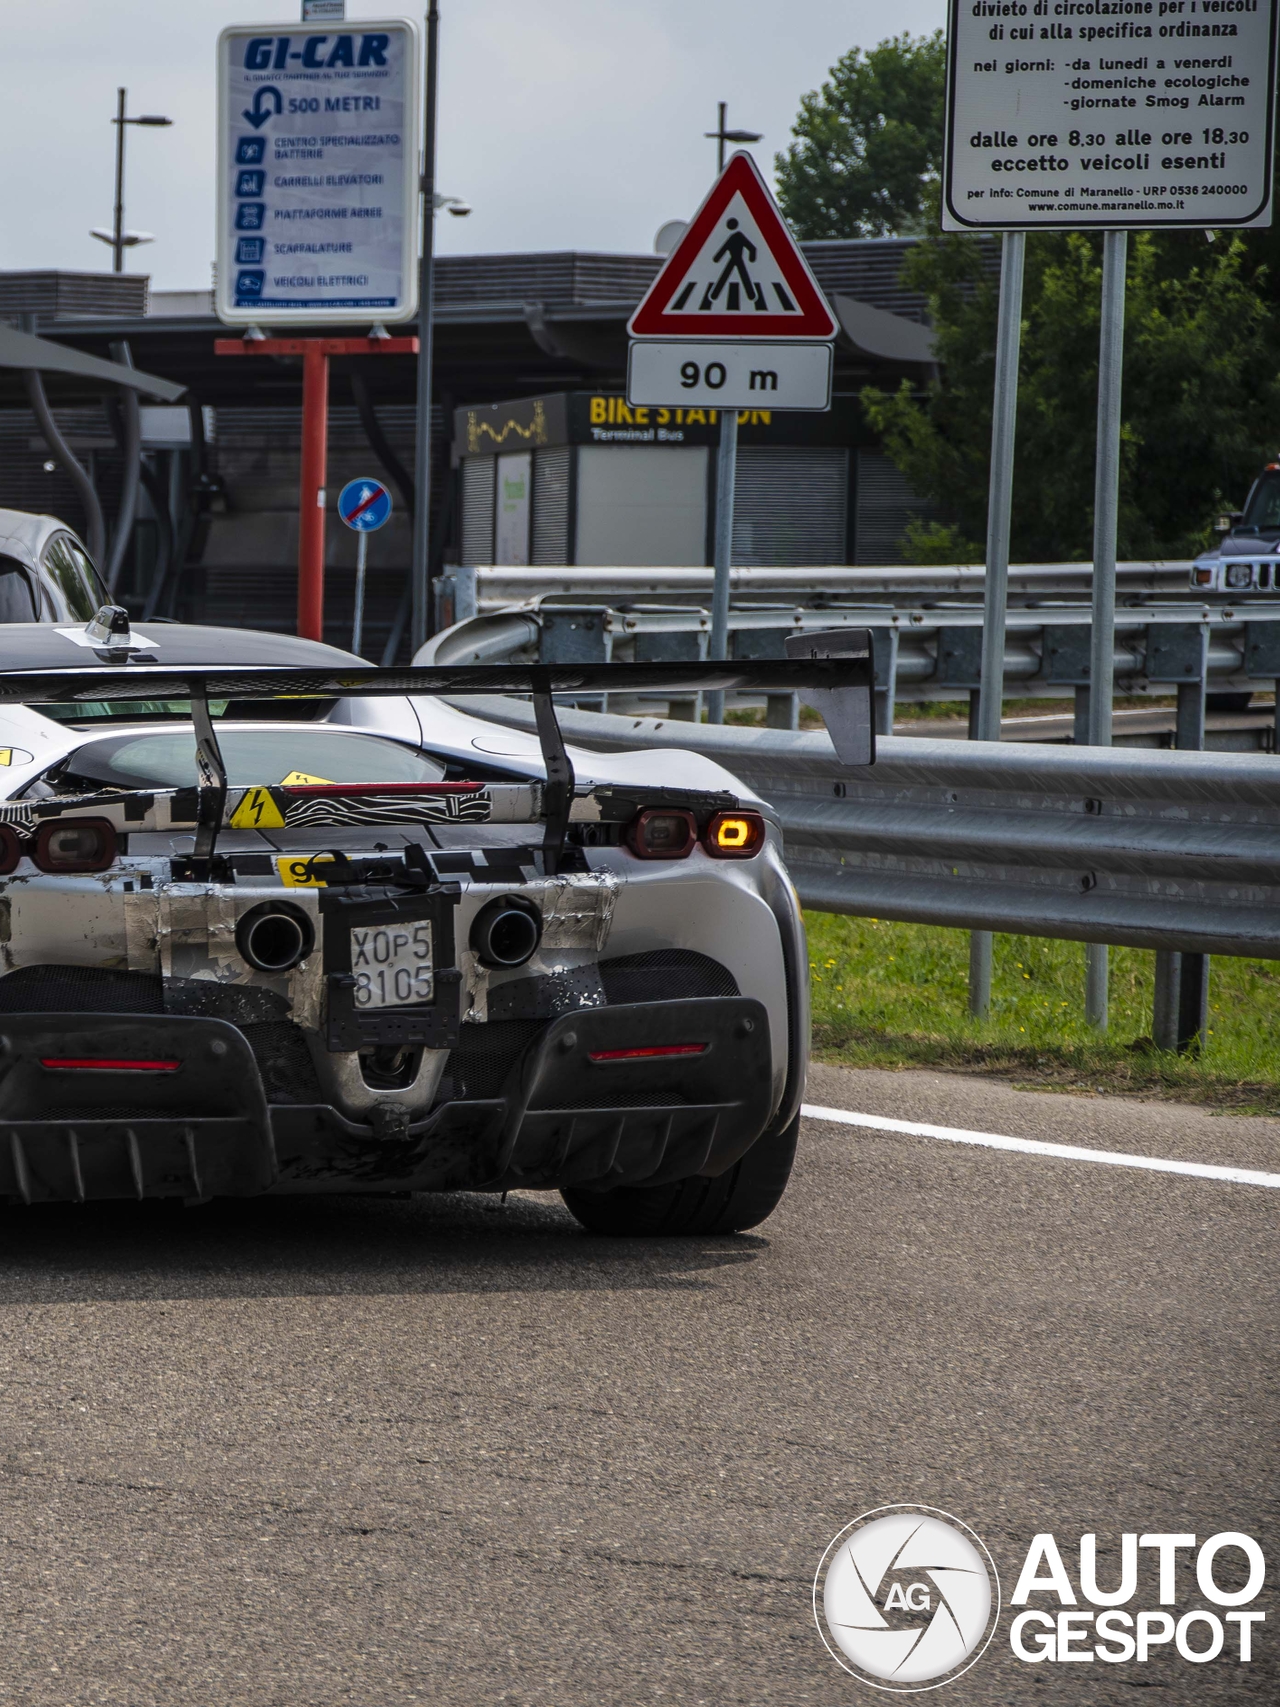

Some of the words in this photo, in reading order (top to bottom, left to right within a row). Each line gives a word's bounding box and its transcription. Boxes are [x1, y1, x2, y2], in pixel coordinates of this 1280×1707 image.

[972, 0, 1027, 16] divieto
[1033, 0, 1048, 16] di
[1054, 0, 1153, 15] circolazione
[1158, 1, 1185, 17] per
[1191, 0, 1196, 13] i
[1203, 0, 1258, 13] veicoli
[989, 23, 1004, 40] di
[1010, 23, 1034, 40] cui
[1040, 23, 1072, 39] alla
[1079, 22, 1152, 42] specifica
[1159, 21, 1238, 37] ordinanza
[243, 34, 389, 71] GI-CAR
[974, 59, 997, 71] nei
[1005, 58, 1055, 74] giorni:
[1099, 57, 1148, 70] lunedi
[1156, 59, 1165, 69] a
[1174, 55, 1233, 69] venerdi
[1064, 76, 1156, 89] -domeniche
[1164, 74, 1250, 89] ecologiche
[288, 98, 319, 114] 500
[324, 96, 381, 112] METRI
[1063, 95, 1137, 111] -giornate
[1145, 94, 1189, 109] Smog
[1198, 93, 1245, 106] Alarm
[275, 136, 316, 148] CENTRO
[320, 134, 400, 147] SPECIALIZZATO
[970, 131, 1018, 148] dalle
[1027, 134, 1058, 147] ore
[1115, 129, 1152, 146] alle
[1161, 132, 1193, 145] ore
[274, 148, 323, 160] BATTERIE
[991, 155, 1069, 172] eccetto
[1081, 153, 1150, 171] veicoli
[1161, 152, 1226, 170] esenti
[274, 175, 321, 188] CARRELLI
[326, 174, 383, 186] ELEVATORI
[967, 190, 984, 200] per
[989, 188, 1014, 198] info:
[1016, 188, 1060, 198] Comune
[1064, 187, 1075, 197] di
[1080, 187, 1134, 197] Maranello
[1143, 186, 1168, 196] URP
[1169, 185, 1199, 196] 0536
[1201, 184, 1248, 195] 240000
[274, 208, 347, 220] PIATTAFORME
[350, 207, 383, 218] AEREE
[1028, 200, 1185, 212] www.comune.maranello.mo.it
[274, 242, 353, 254] SCAFFALATURE
[274, 275, 315, 288] VEICOLI
[317, 274, 368, 287] ELETTRICI
[679, 360, 727, 390] 90
[748, 369, 778, 391] m
[590, 396, 650, 425] BIKE
[590, 427, 654, 441] Terminal
[657, 426, 684, 441] Bus
[355, 965, 432, 1006] 8105
